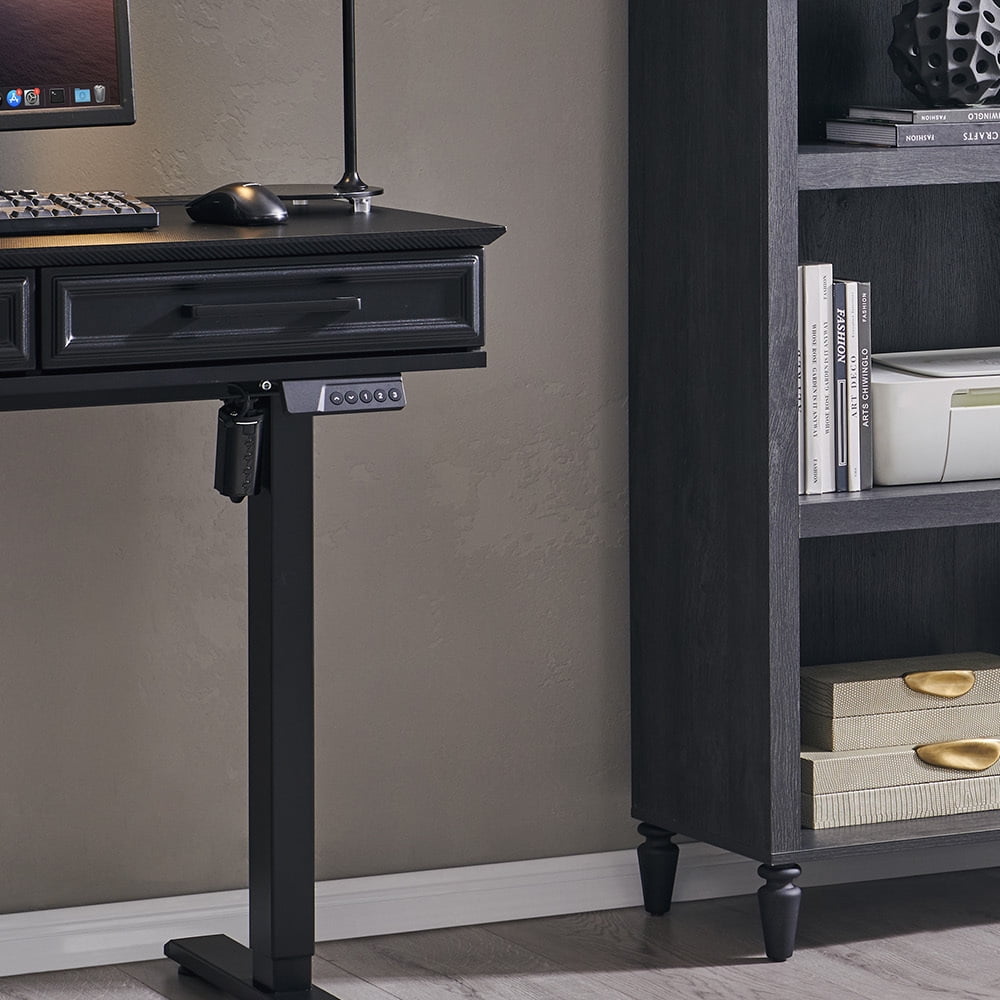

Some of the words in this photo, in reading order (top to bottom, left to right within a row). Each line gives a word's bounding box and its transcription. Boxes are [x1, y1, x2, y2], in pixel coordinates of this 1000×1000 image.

[906, 134, 935, 142] FASHION
[962, 131, 998, 141] CRAFTS
[837, 308, 845, 364] FASHION
[861, 348, 869, 400] CHIWINGLO
[861, 403, 869, 427] ARTS
